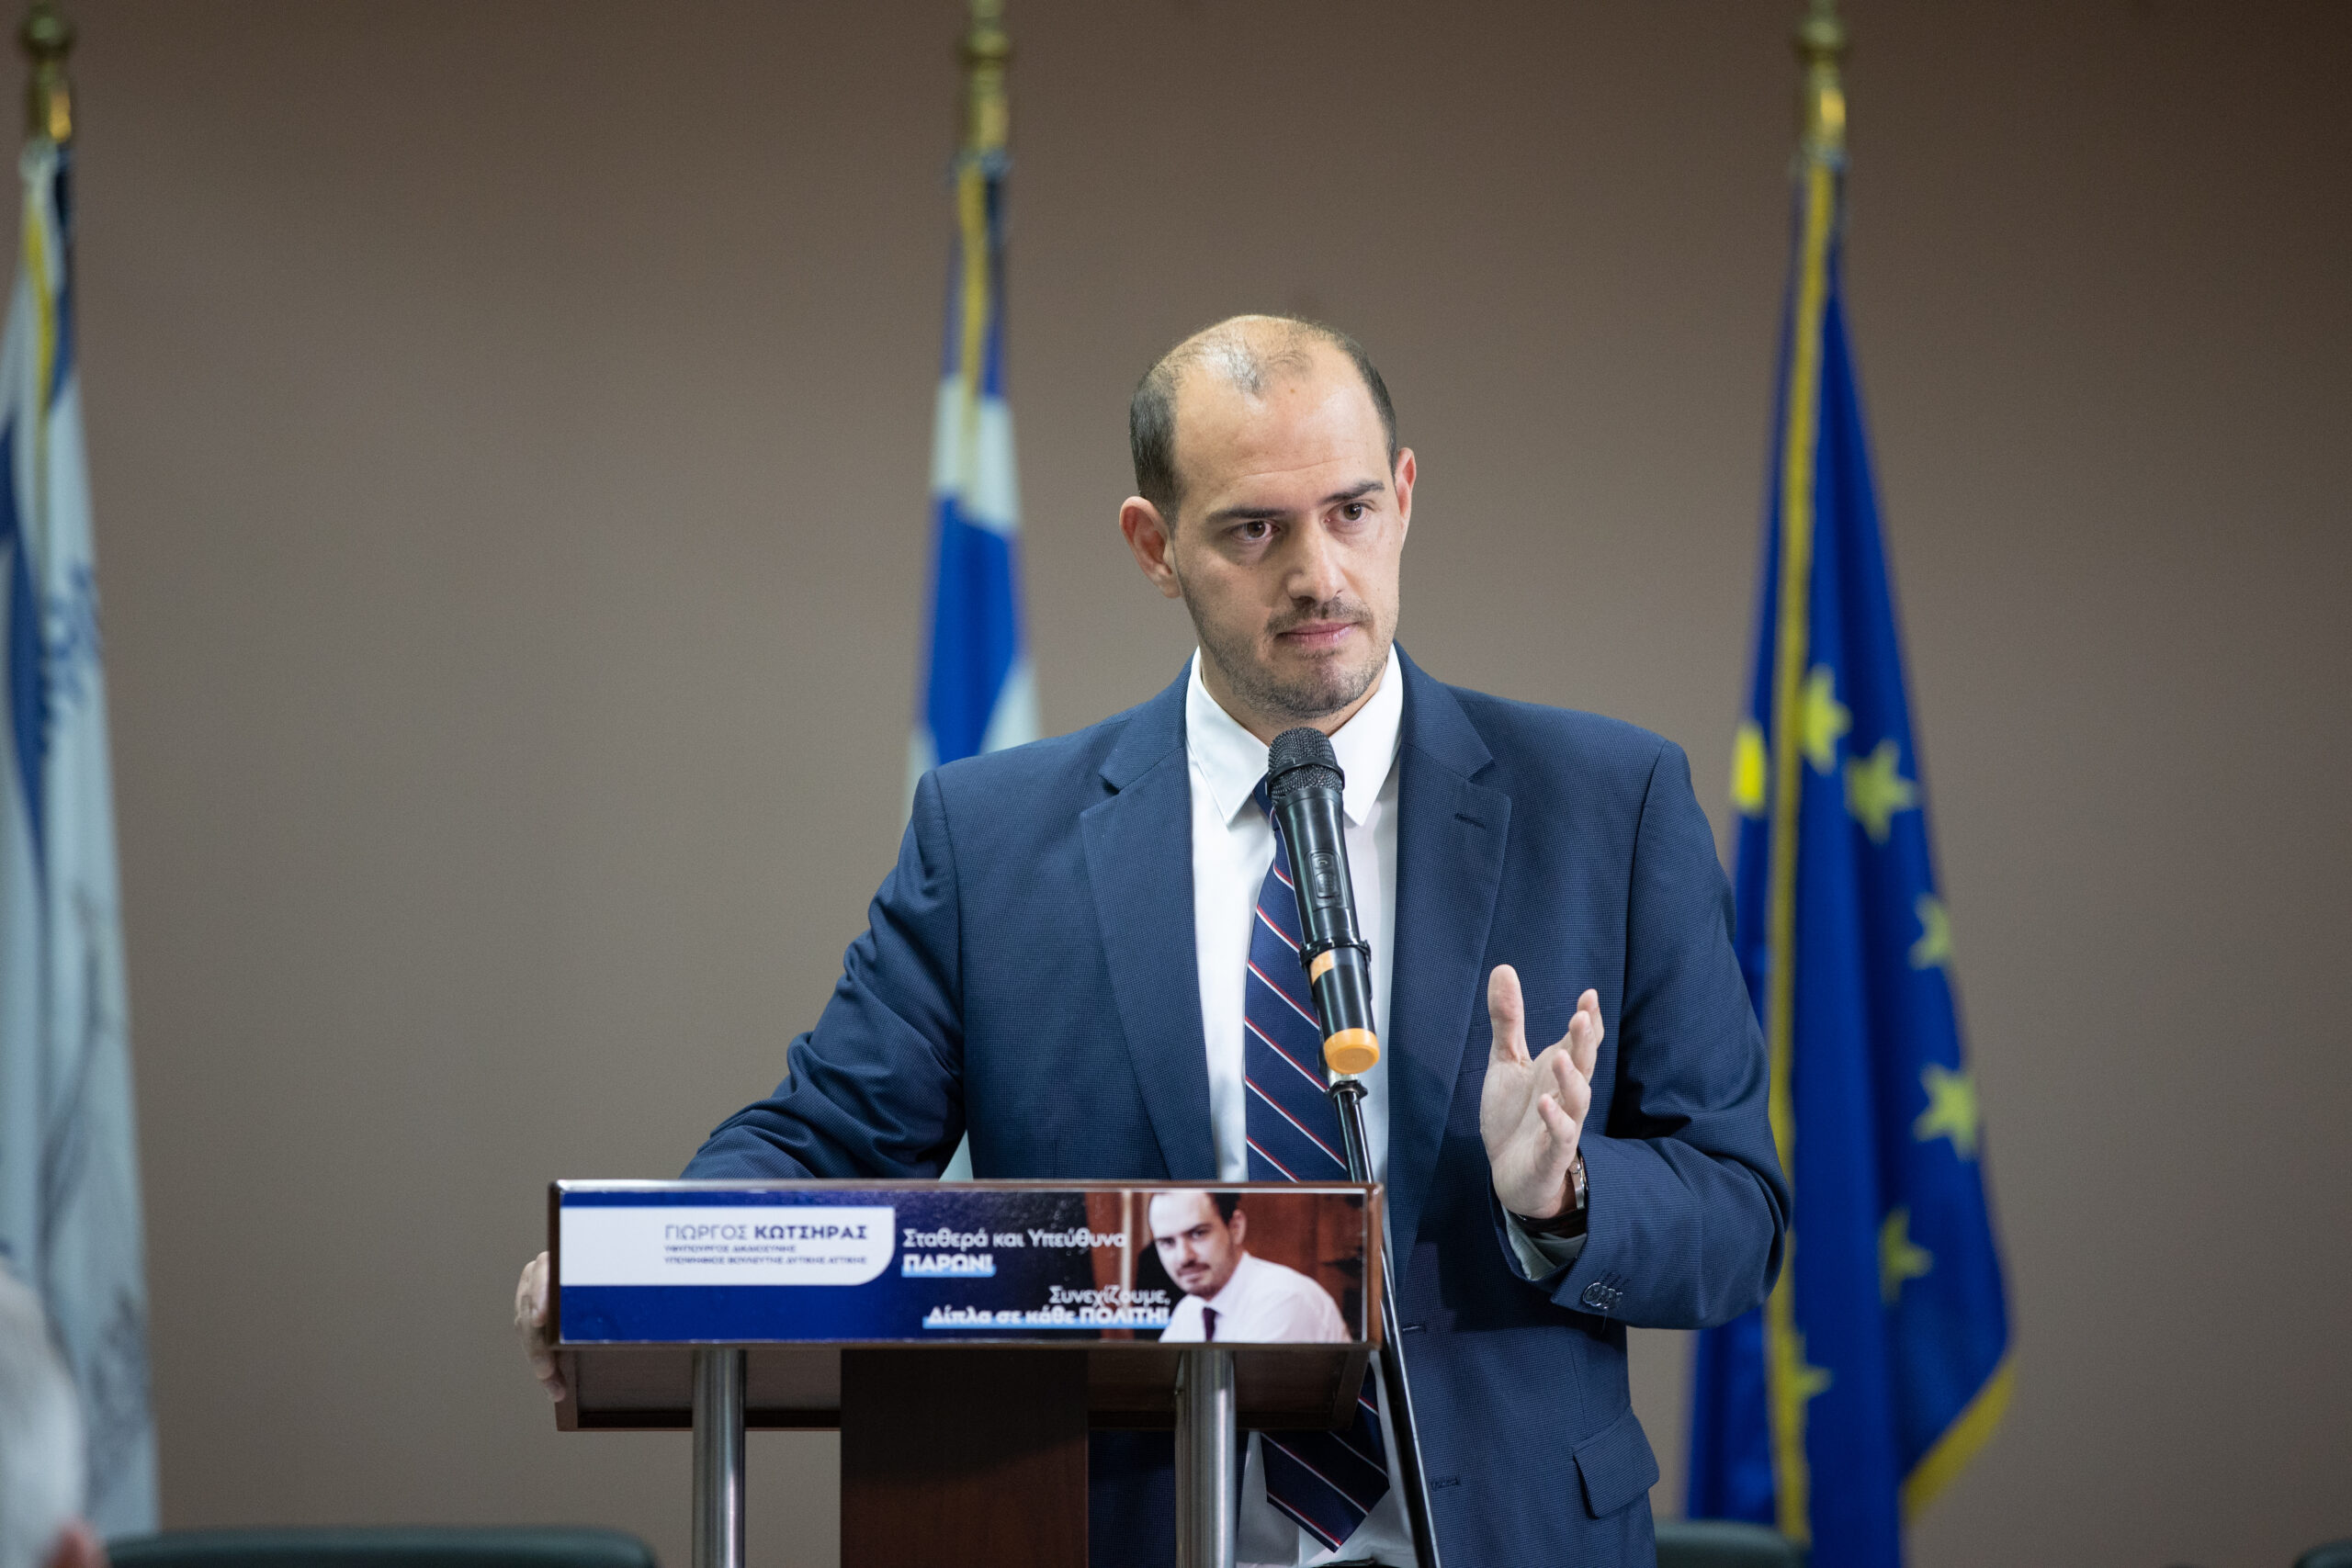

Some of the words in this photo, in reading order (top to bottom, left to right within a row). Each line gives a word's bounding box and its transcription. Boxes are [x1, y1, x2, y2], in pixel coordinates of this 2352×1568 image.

[664, 1224, 748, 1240] ΓΙΩΡΓΟΣ
[753, 1224, 868, 1239] ΚΩΤΣΗΡΑΣ
[902, 1227, 989, 1251] Σταθερά
[992, 1232, 1025, 1247] και
[902, 1254, 994, 1273] ΠΑΡΩΝ!
[927, 1305, 992, 1325] Δίπλα
[995, 1311, 1021, 1325] σε
[1024, 1305, 1076, 1325] κάθε
[1079, 1306, 1170, 1325] ΠΟΛΙΤΗ!
